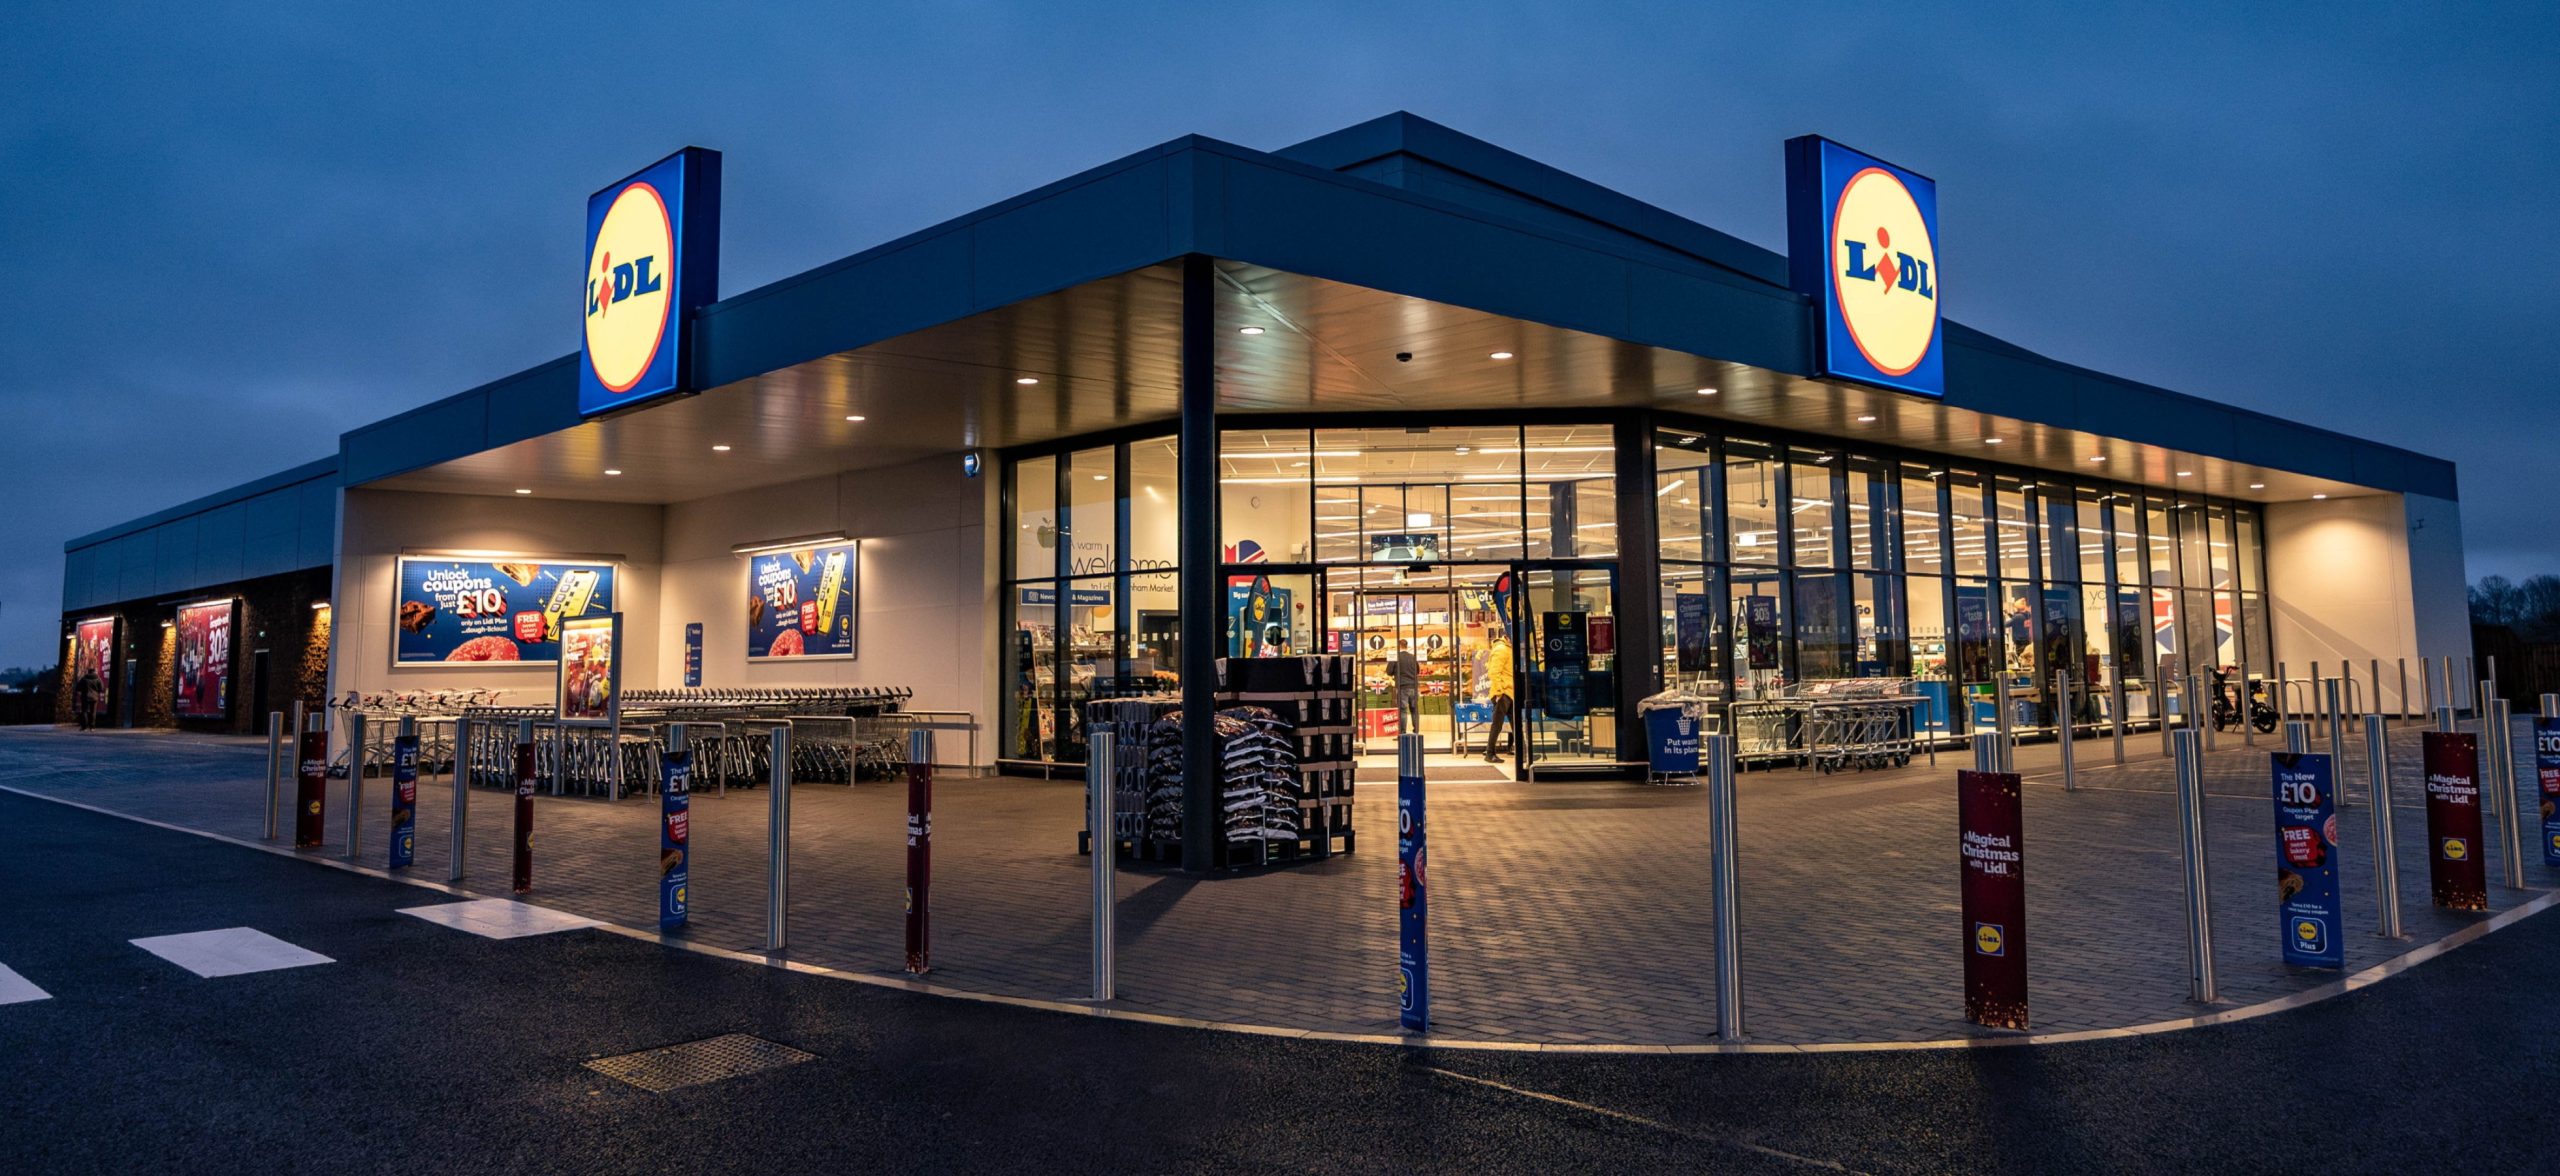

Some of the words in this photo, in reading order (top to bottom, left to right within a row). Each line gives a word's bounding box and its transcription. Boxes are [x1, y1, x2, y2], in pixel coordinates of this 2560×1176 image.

[1077, 542, 1102, 550] warm
[428, 569, 469, 581] Unlock
[422, 577, 492, 593] coupons
[435, 593, 456, 601] from
[774, 579, 795, 607] £10
[440, 601, 456, 610] just
[456, 588, 502, 614] £10
[802, 603, 815, 614] FREE
[517, 613, 540, 624] FREE
[2280, 773, 2293, 781] The
[2433, 773, 2470, 785] Magical
[2281, 782, 2316, 804] £10
[2428, 782, 2477, 795] Christmas
[2450, 794, 2468, 804] Lidl
[2282, 806, 2303, 815] Coupon
[1968, 830, 2011, 848] Magical
[2284, 829, 2311, 841] FREE
[1962, 842, 2019, 861] Christmas
[1970, 859, 1983, 869] with
[1984, 861, 2007, 875] Lidl
[2300, 941, 2316, 950] Plus
